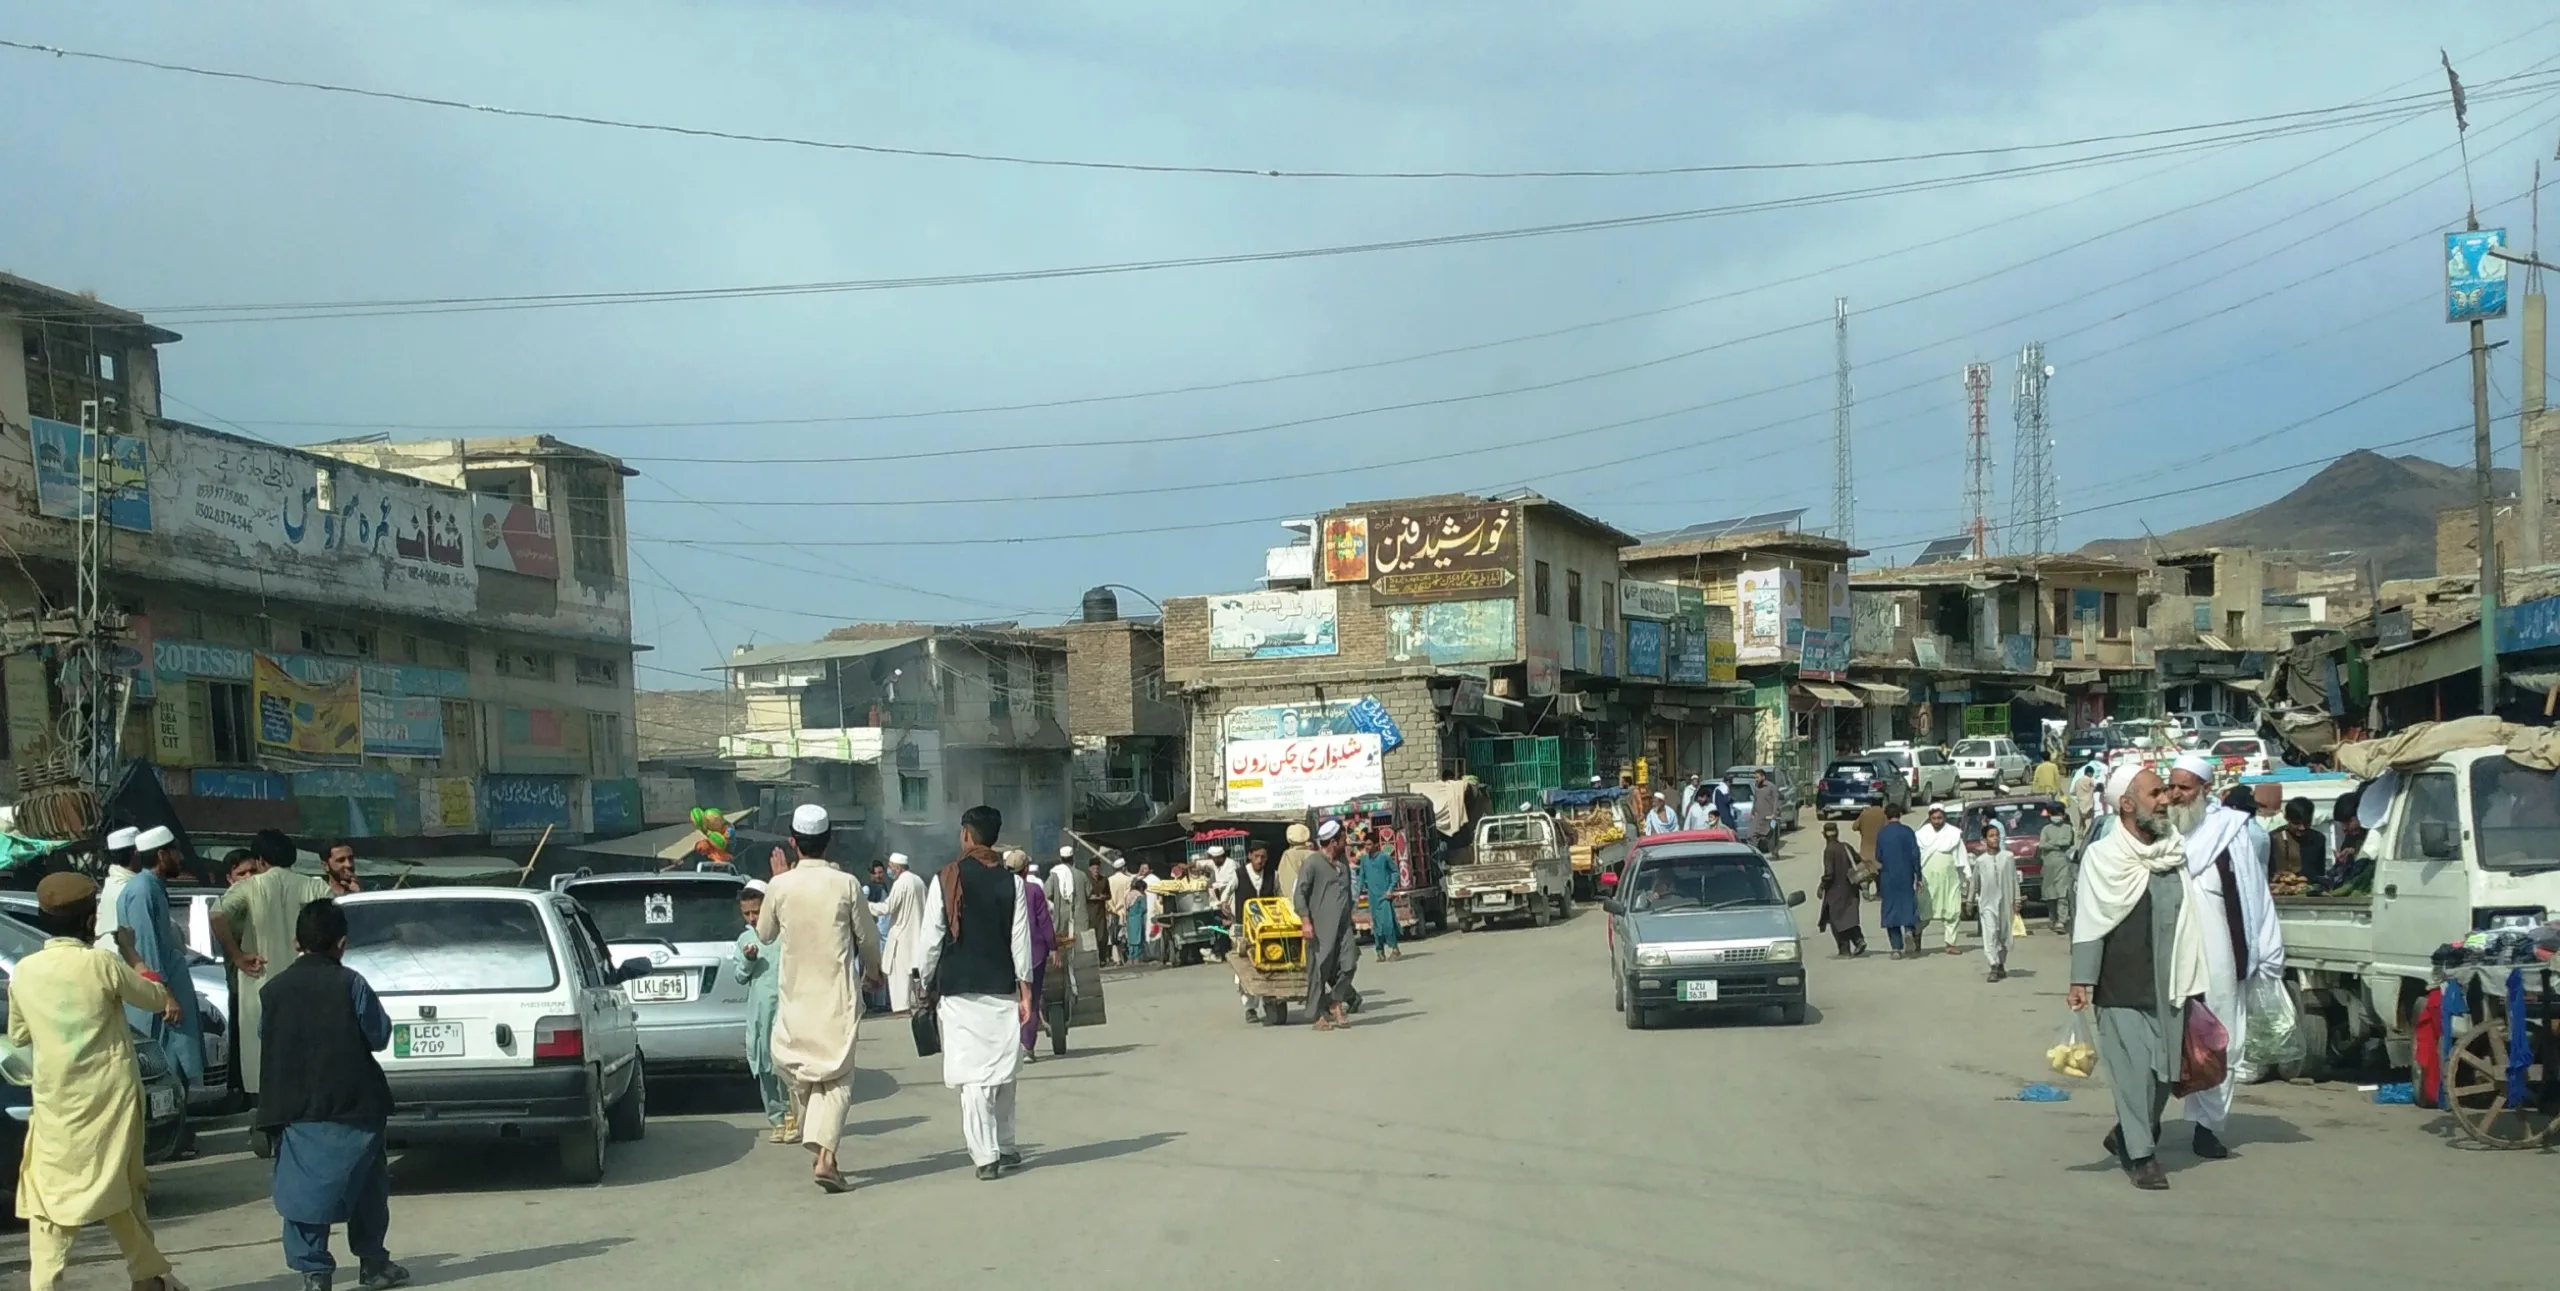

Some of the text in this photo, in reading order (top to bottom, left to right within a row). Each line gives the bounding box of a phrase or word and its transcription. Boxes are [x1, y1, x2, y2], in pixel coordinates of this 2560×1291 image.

[1375, 508, 1511, 573] خورشید فین
[304, 659, 403, 692] INSTUTE
[162, 735, 180, 749] CIT
[1269, 743, 1299, 776] چکن
[637, 978, 682, 994] LKL 515
[1689, 982, 1706, 991] LZU
[414, 1026, 440, 1039] LEC
[412, 1040, 445, 1053] 4709
